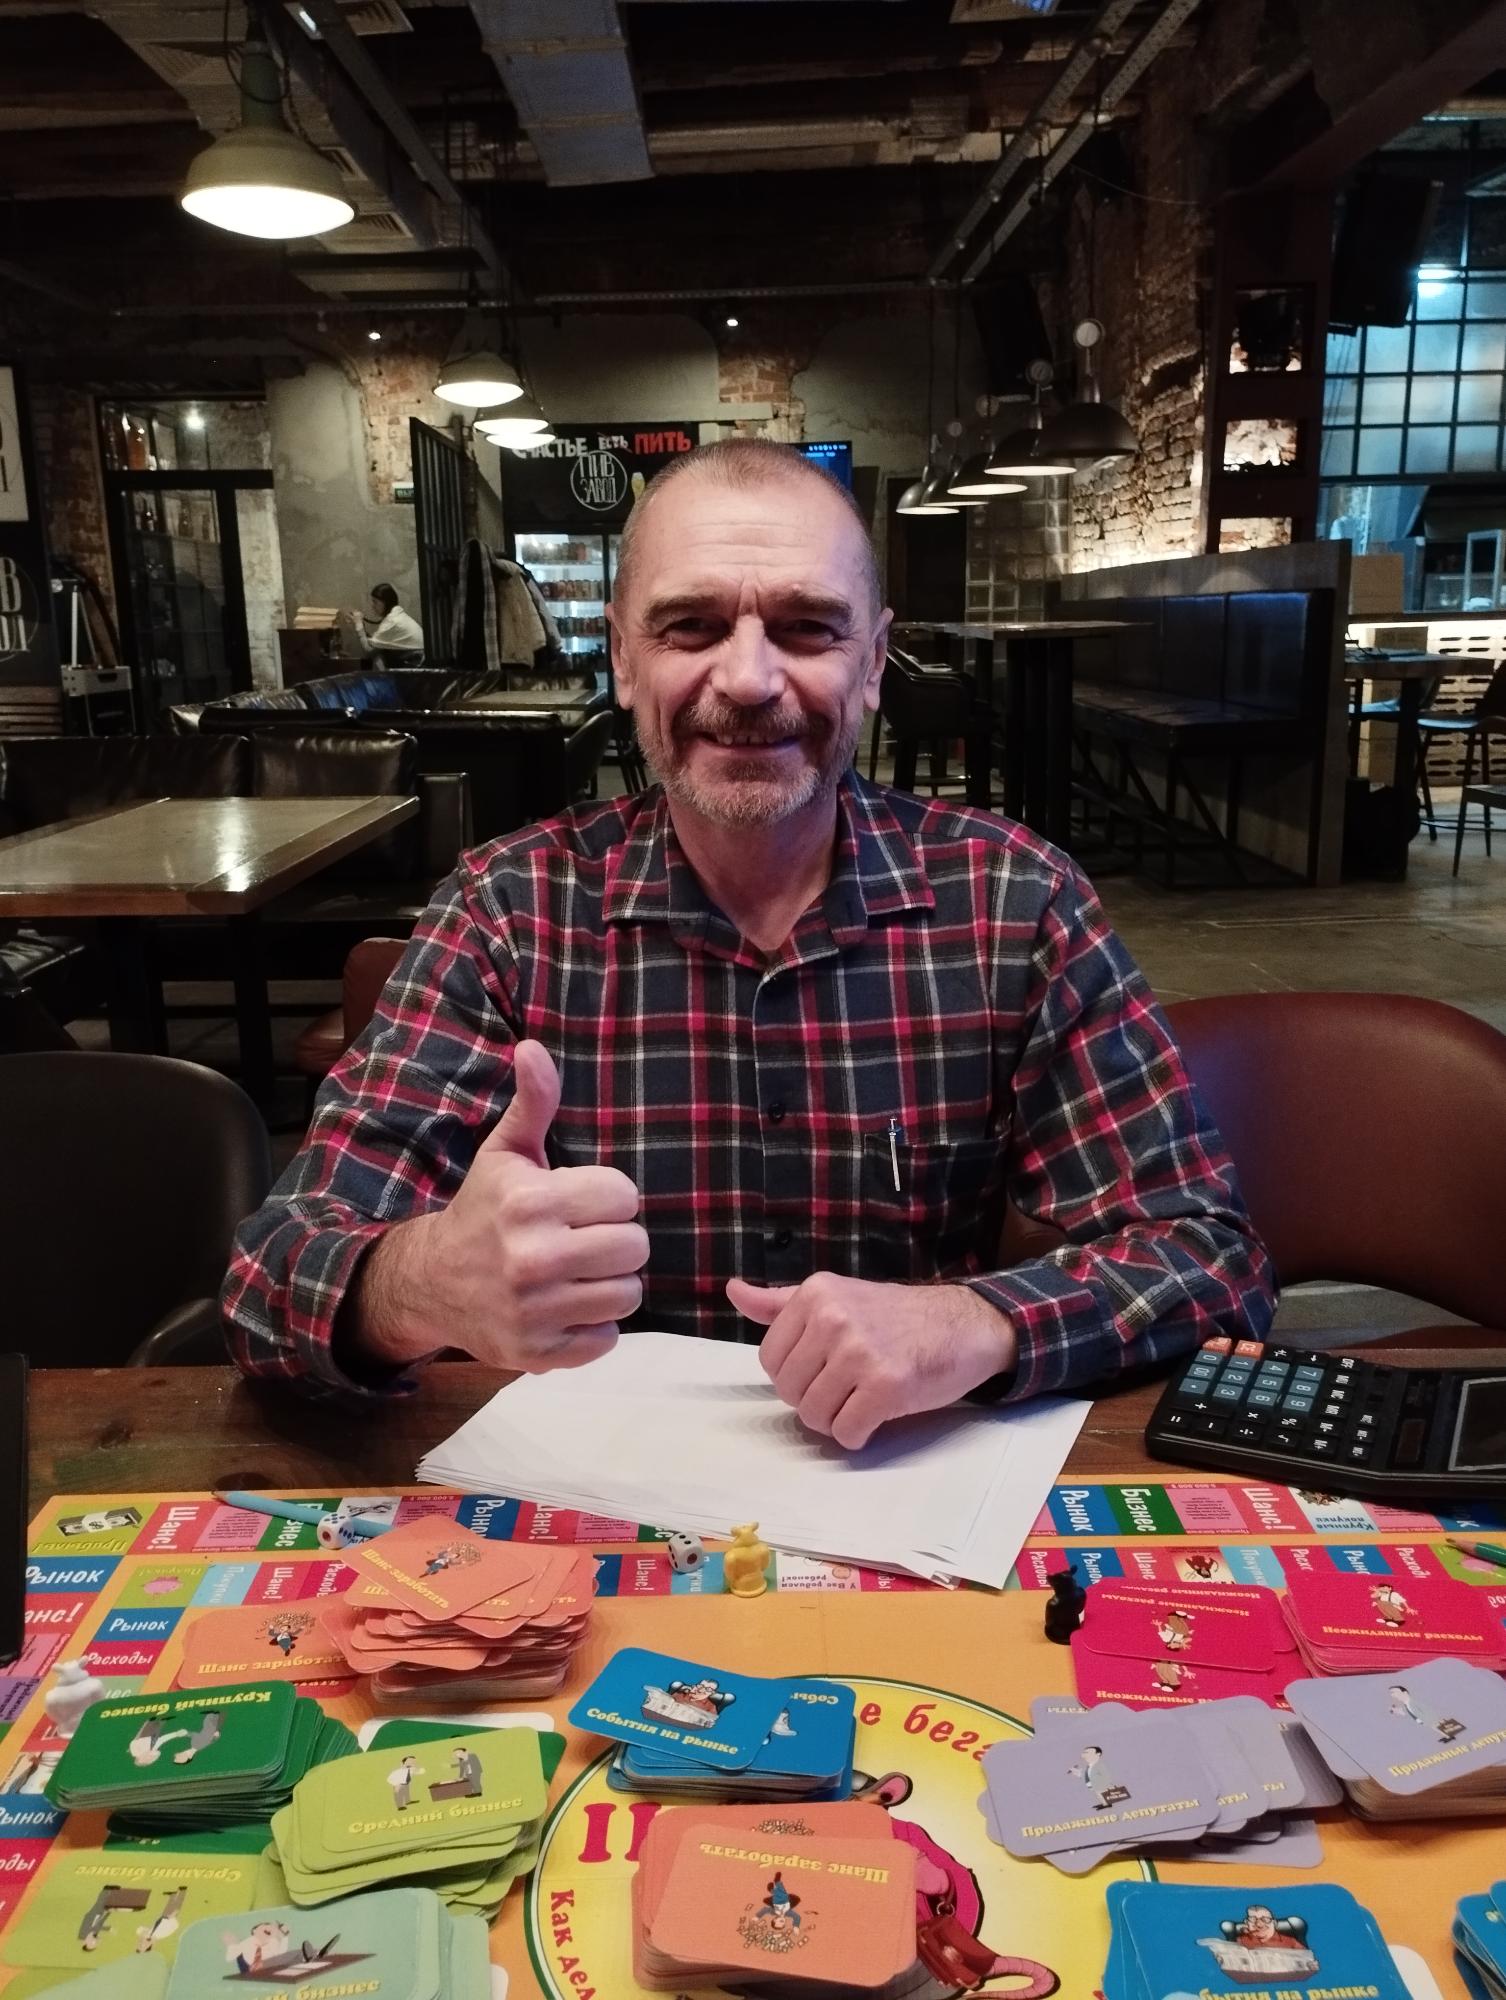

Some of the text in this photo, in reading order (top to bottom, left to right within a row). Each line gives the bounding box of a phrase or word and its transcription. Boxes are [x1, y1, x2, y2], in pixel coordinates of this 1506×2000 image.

[634, 431, 692, 455] ПИТЬ
[1059, 1489, 1095, 1532] Рынок
[1120, 1488, 1157, 1532] Бизнес
[1241, 1487, 1297, 1530] Шанс!
[146, 1506, 200, 1550] Шанс!
[274, 1502, 324, 1547] знес
[1316, 1521, 1375, 1532] Крупные
[33, 1537, 128, 1553] Прибыль!
[1290, 1548, 1314, 1571] Расх
[1343, 1550, 1372, 1575] Рын
[25, 1566, 105, 1585] Рынок
[262, 1566, 295, 1600] Шанс!
[633, 1559, 657, 1591] Шанс!
[109, 1618, 169, 1632] Рынок
[1323, 1625, 1484, 1641] Неожиданные расходы
[86, 1651, 154, 1666] Расходы
[198, 1663, 249, 1675] Шанс
[99, 1691, 272, 1719] Крупный бизнес
[791, 1691, 840, 1706] Собы
[1096, 1690, 1195, 1704] Неожиданные
[586, 1706, 739, 1756] События на рынке
[348, 1796, 524, 1835] Средний бизнес
[1021, 1812, 1119, 1838] Продажные
[1122, 1799, 1201, 1823] депутаты
[699, 1841, 890, 1884] Шанс заработать
[550, 1889, 576, 1948] Как
